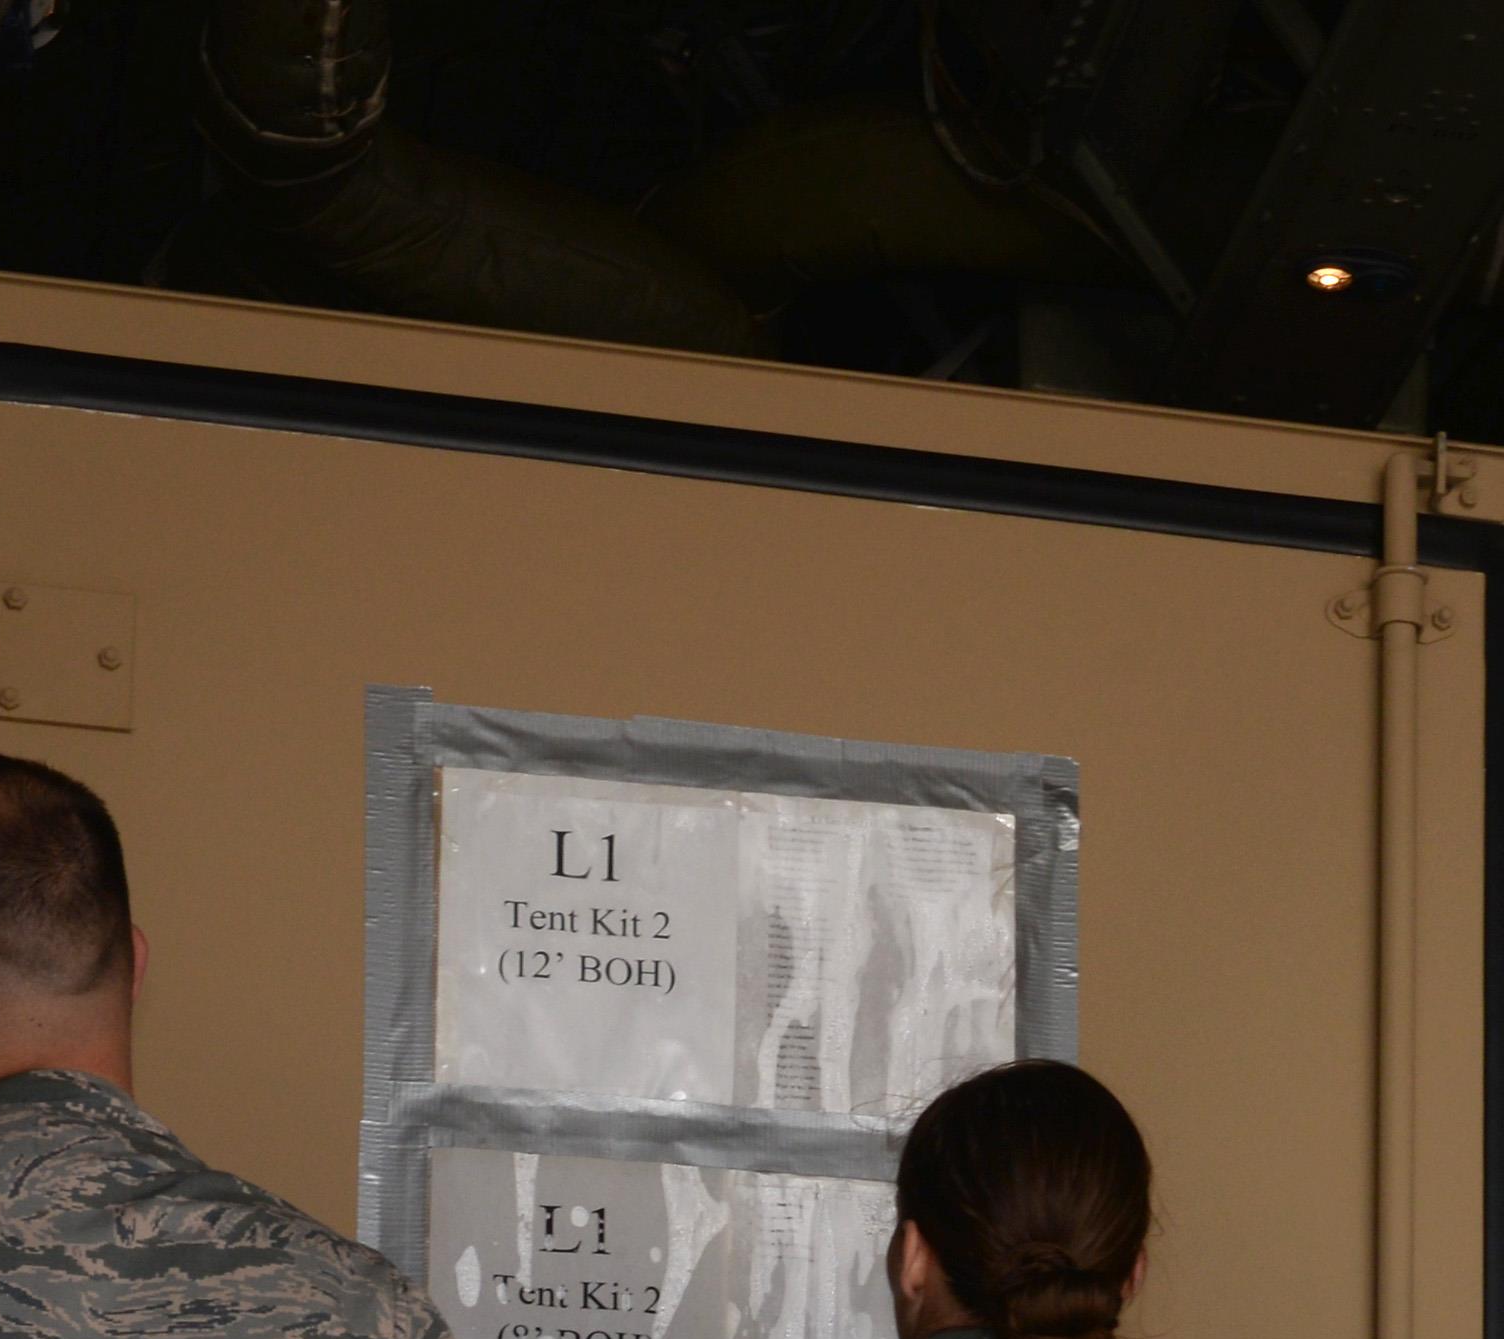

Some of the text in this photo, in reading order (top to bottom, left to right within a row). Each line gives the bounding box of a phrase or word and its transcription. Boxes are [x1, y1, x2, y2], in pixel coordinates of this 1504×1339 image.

[549, 829, 620, 882] L1
[504, 900, 672, 940] Tent Kit 2
[577, 954, 676, 995] BOH)
[538, 1204, 612, 1256] L1
[643, 1285, 662, 1315] 2
